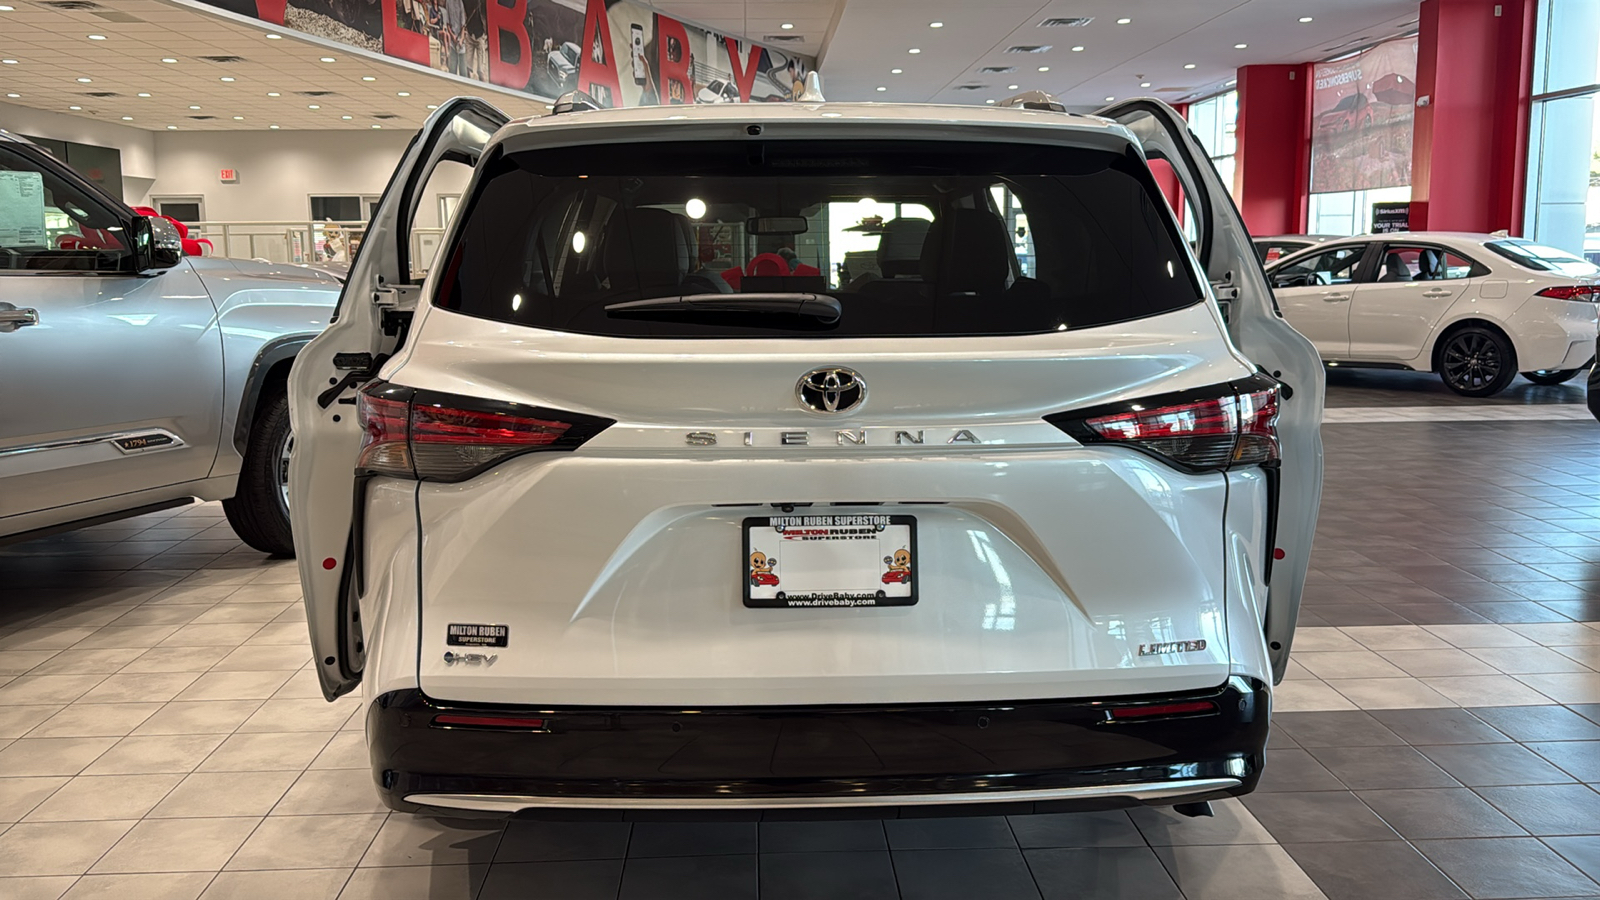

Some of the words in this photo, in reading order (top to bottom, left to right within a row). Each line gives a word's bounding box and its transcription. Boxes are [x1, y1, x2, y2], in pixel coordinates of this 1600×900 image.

[487, 0, 763, 108] BABY
[221, 169, 234, 179] EXIT
[684, 429, 982, 446] SIENNA
[769, 516, 802, 526] MILTON
[804, 516, 833, 526] RUBEN
[834, 515, 891, 526] SUPERSTORE
[782, 528, 828, 536] MILTON
[787, 598, 876, 607] www.drivebaby.com
[449, 625, 478, 637] MILTON
[479, 626, 506, 637] RUBEN
[1138, 639, 1207, 657] LIMITED
